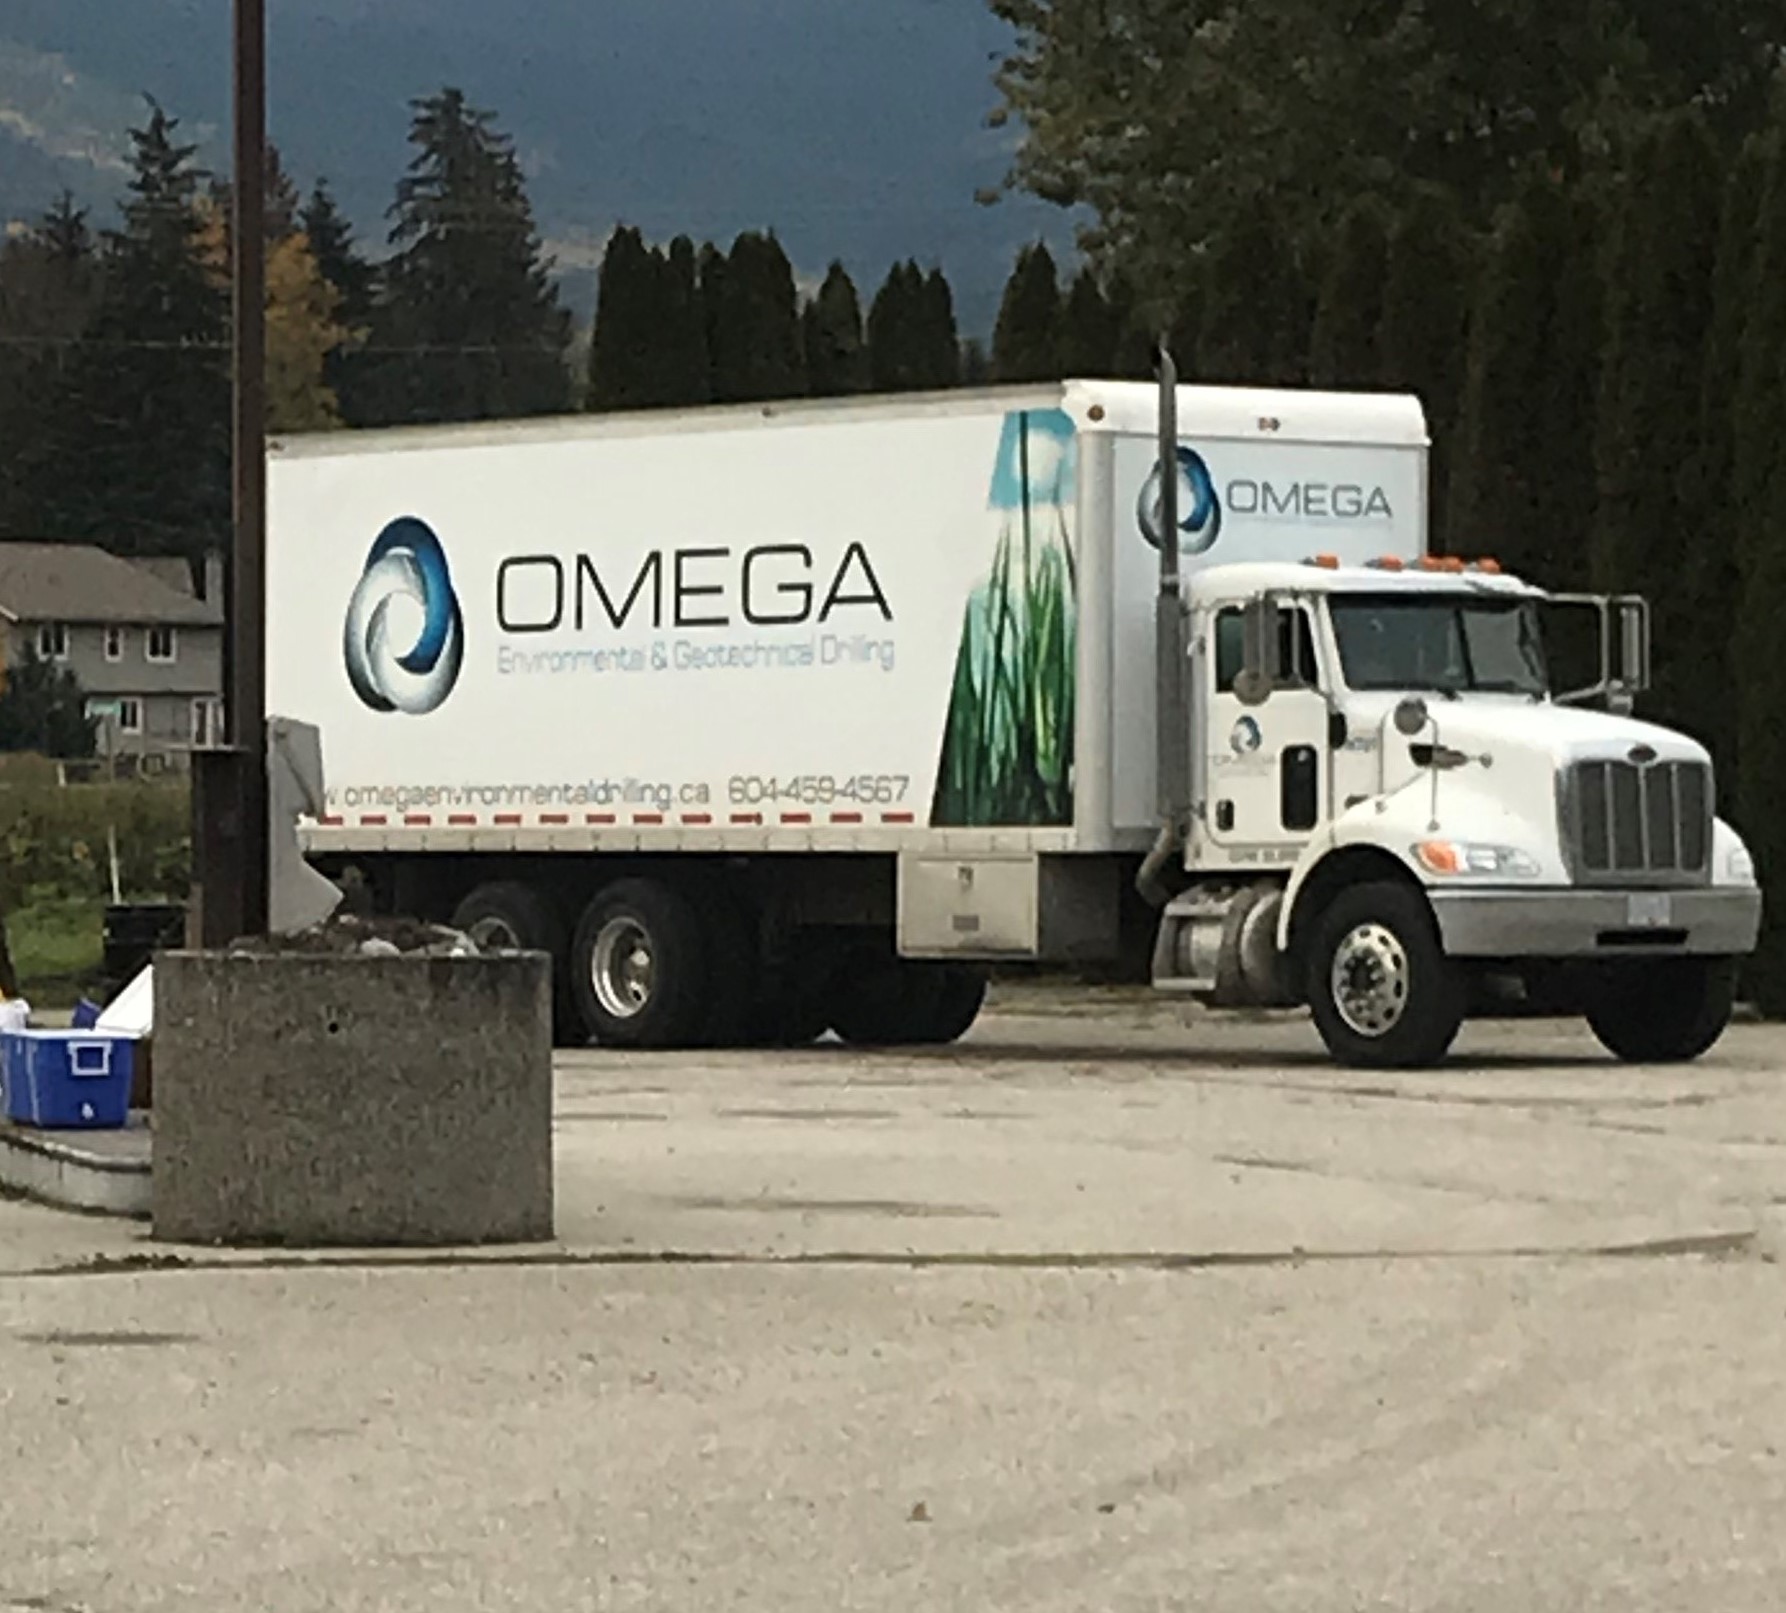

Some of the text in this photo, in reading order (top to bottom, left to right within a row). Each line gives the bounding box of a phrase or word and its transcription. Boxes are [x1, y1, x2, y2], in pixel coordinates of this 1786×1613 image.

[1226, 479, 1393, 518] OMEGA
[496, 541, 893, 633] OMEGA
[497, 634, 895, 674] Environmental & Geotechnical Drilling
[728, 775, 910, 805] 604-459-4567
